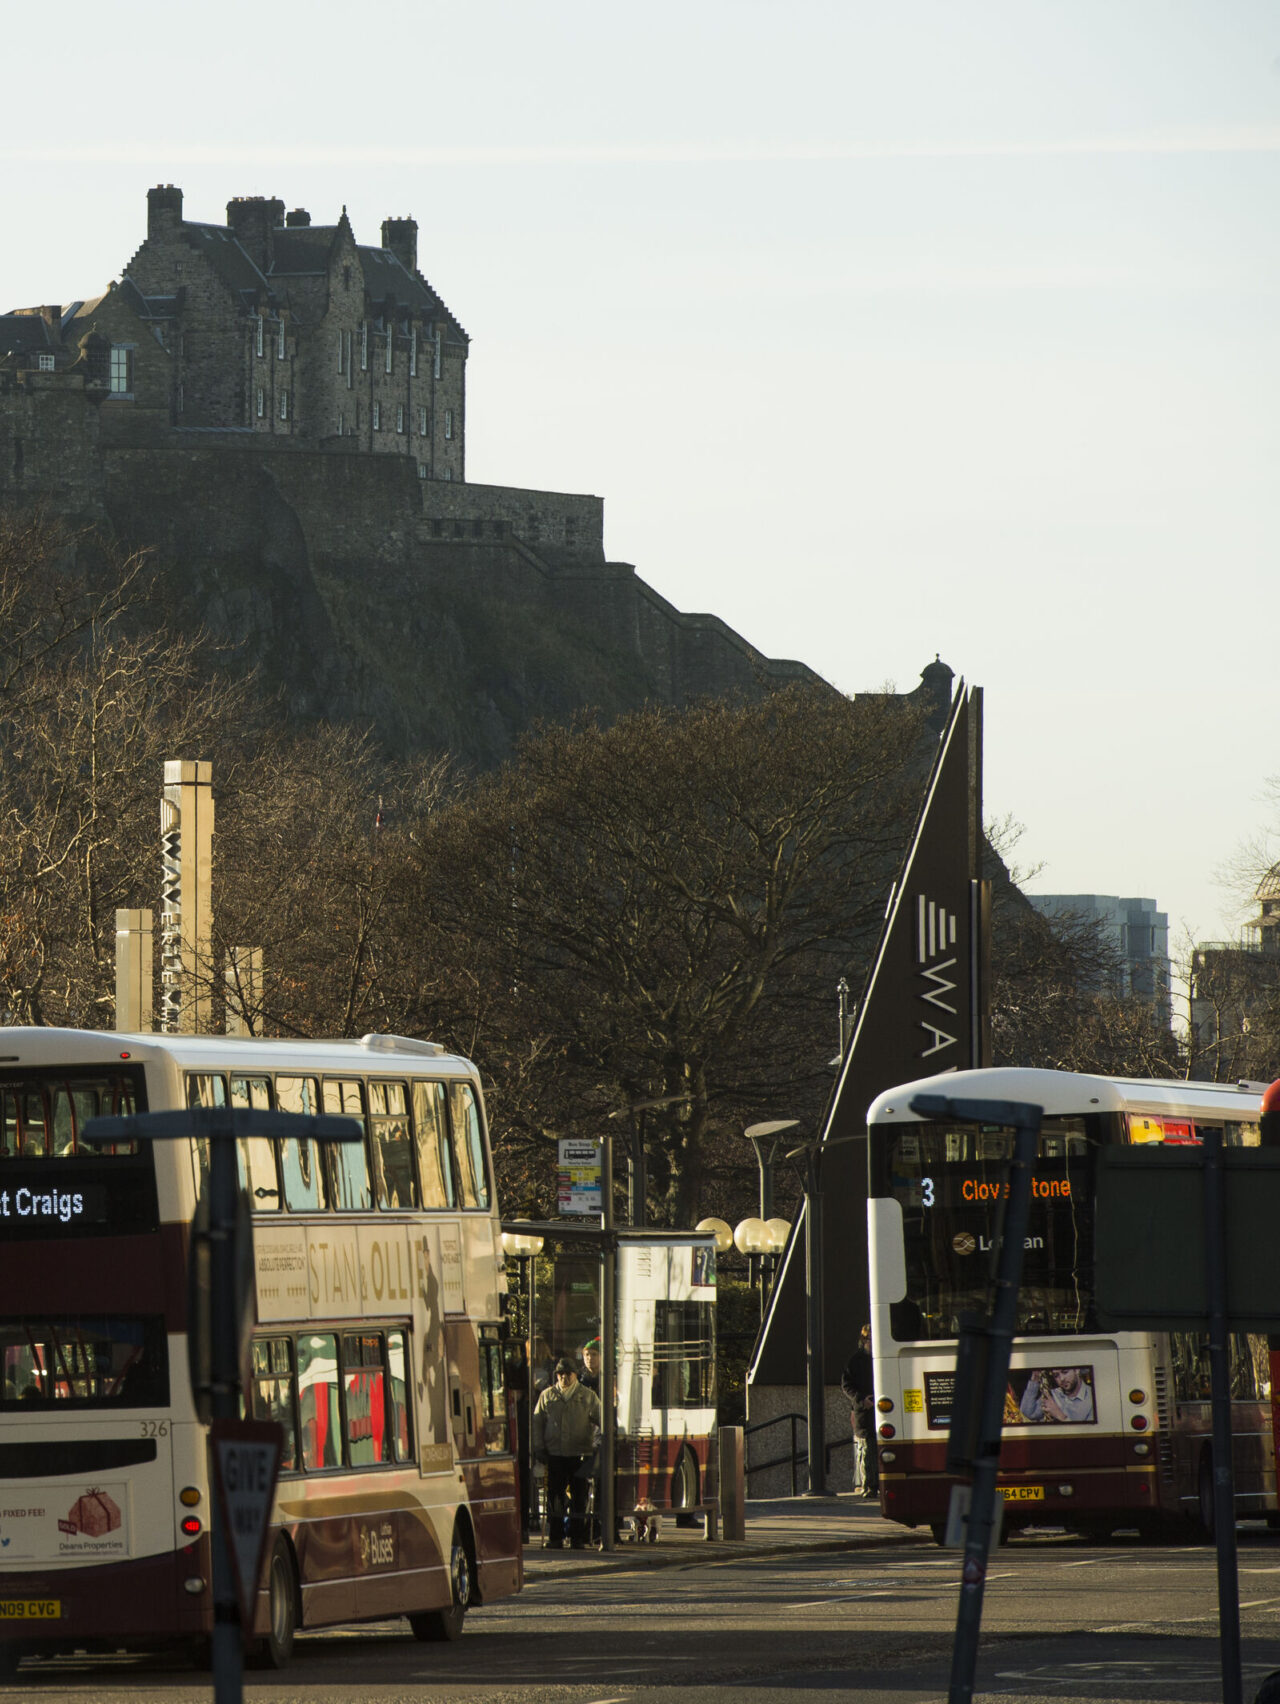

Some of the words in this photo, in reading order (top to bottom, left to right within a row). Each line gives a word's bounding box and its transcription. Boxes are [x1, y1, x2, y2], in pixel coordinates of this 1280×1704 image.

[161, 830, 175, 1006] WAVERLEY
[920, 957, 958, 1078] WA
[15, 1188, 83, 1222] Craigs
[921, 1177, 935, 1207] 3
[962, 1177, 1071, 1200] Clovetone
[309, 1242, 357, 1304] STAN
[360, 1263, 368, 1301] &
[370, 1239, 424, 1301] OLLIE
[140, 1421, 168, 1437] 326
[227, 1448, 267, 1492] GIVE
[1019, 1488, 1040, 1499] CPV
[3, 1509, 27, 1518] FIXED
[28, 1508, 45, 1517] FEE!
[59, 1542, 83, 1551] Deans
[83, 1540, 123, 1552] Properties
[371, 1531, 394, 1564] Buses
[28, 1602, 55, 1616] CVG
